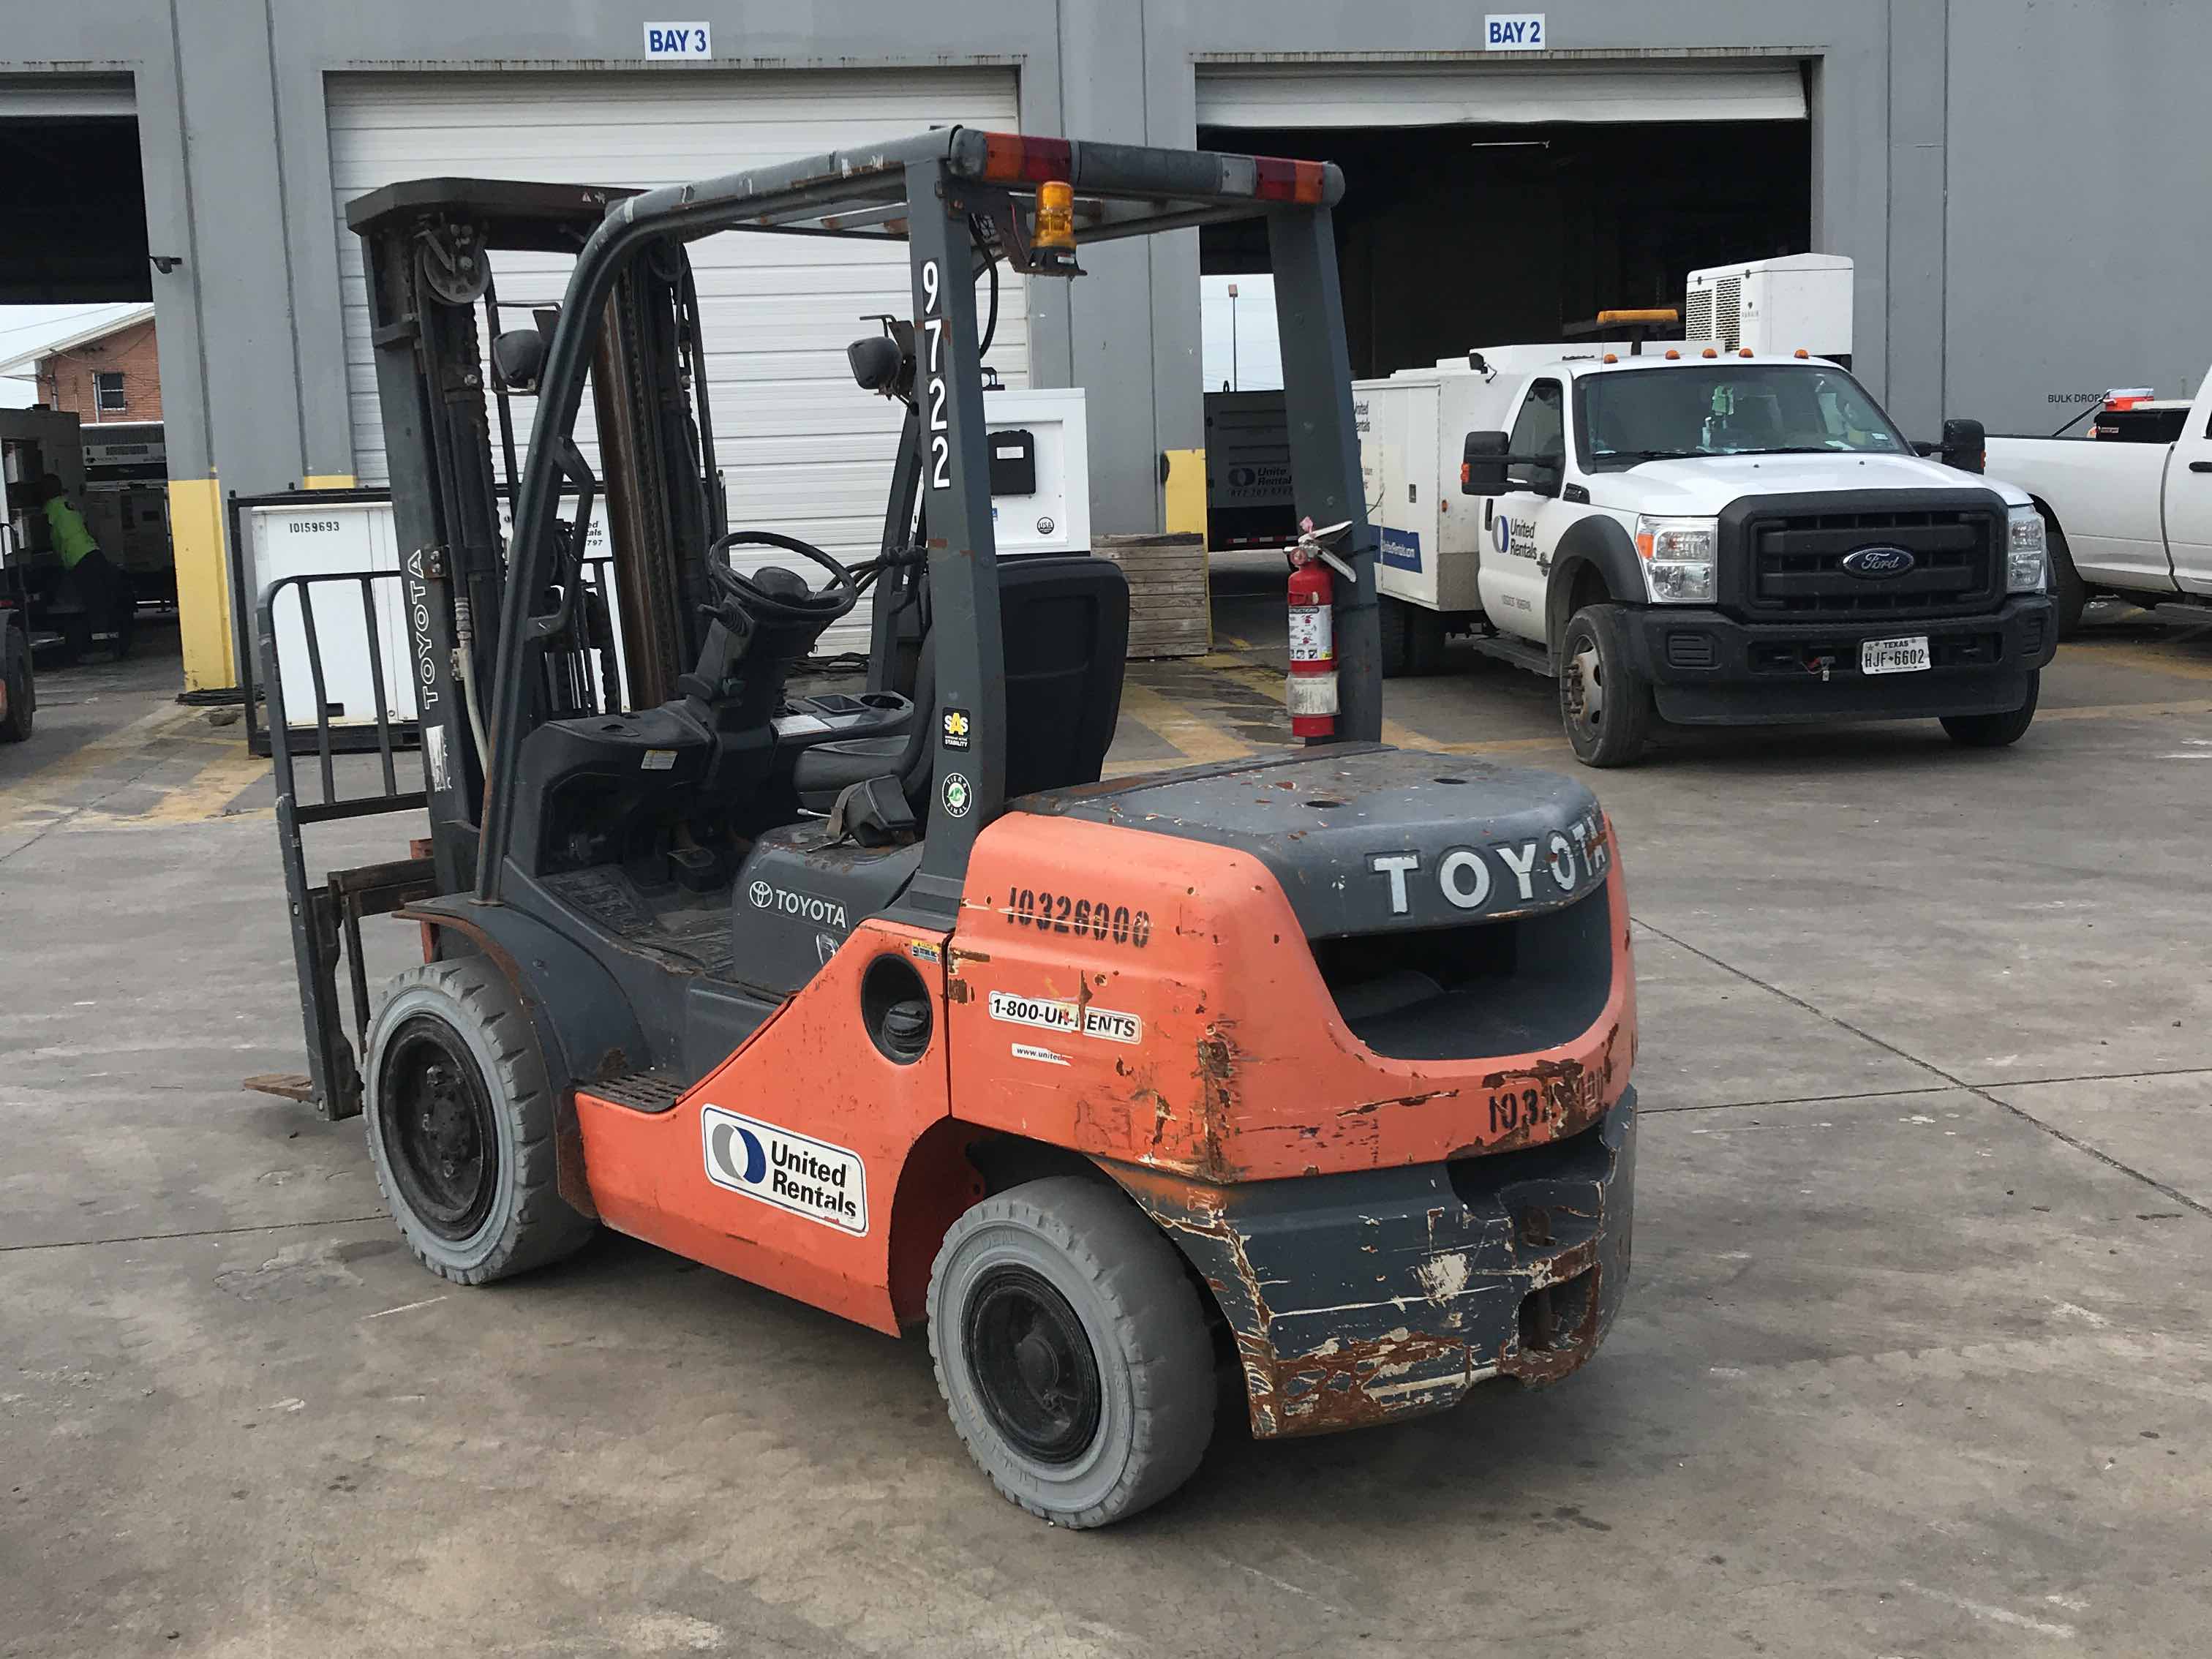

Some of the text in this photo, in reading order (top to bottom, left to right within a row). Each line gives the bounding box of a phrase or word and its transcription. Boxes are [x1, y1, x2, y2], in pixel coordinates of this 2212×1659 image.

[650, 29, 706, 52] BAY 3
[1489, 21, 1540, 43] BAY 2
[923, 260, 950, 489] 9722
[2048, 394, 2101, 403] BULK DROP
[1357, 418, 1370, 433] entals
[1257, 467, 1288, 476] Unite
[1257, 475, 1293, 486] Rental
[289, 522, 339, 533] 10159693
[1510, 518, 1536, 538] United
[1510, 538, 1537, 560] Rentals
[1861, 553, 1900, 569] Ford
[407, 549, 440, 710] TOYOTA
[1884, 640, 1909, 649] TEXAS
[944, 712, 968, 735] SAS
[947, 802, 967, 814] FINAL
[1374, 816, 1606, 914] TOYOTA
[775, 889, 846, 928] TOYOTA
[1007, 886, 1151, 948] 10326000
[771, 1140, 847, 1189] United
[772, 1168, 857, 1218] Rentals
